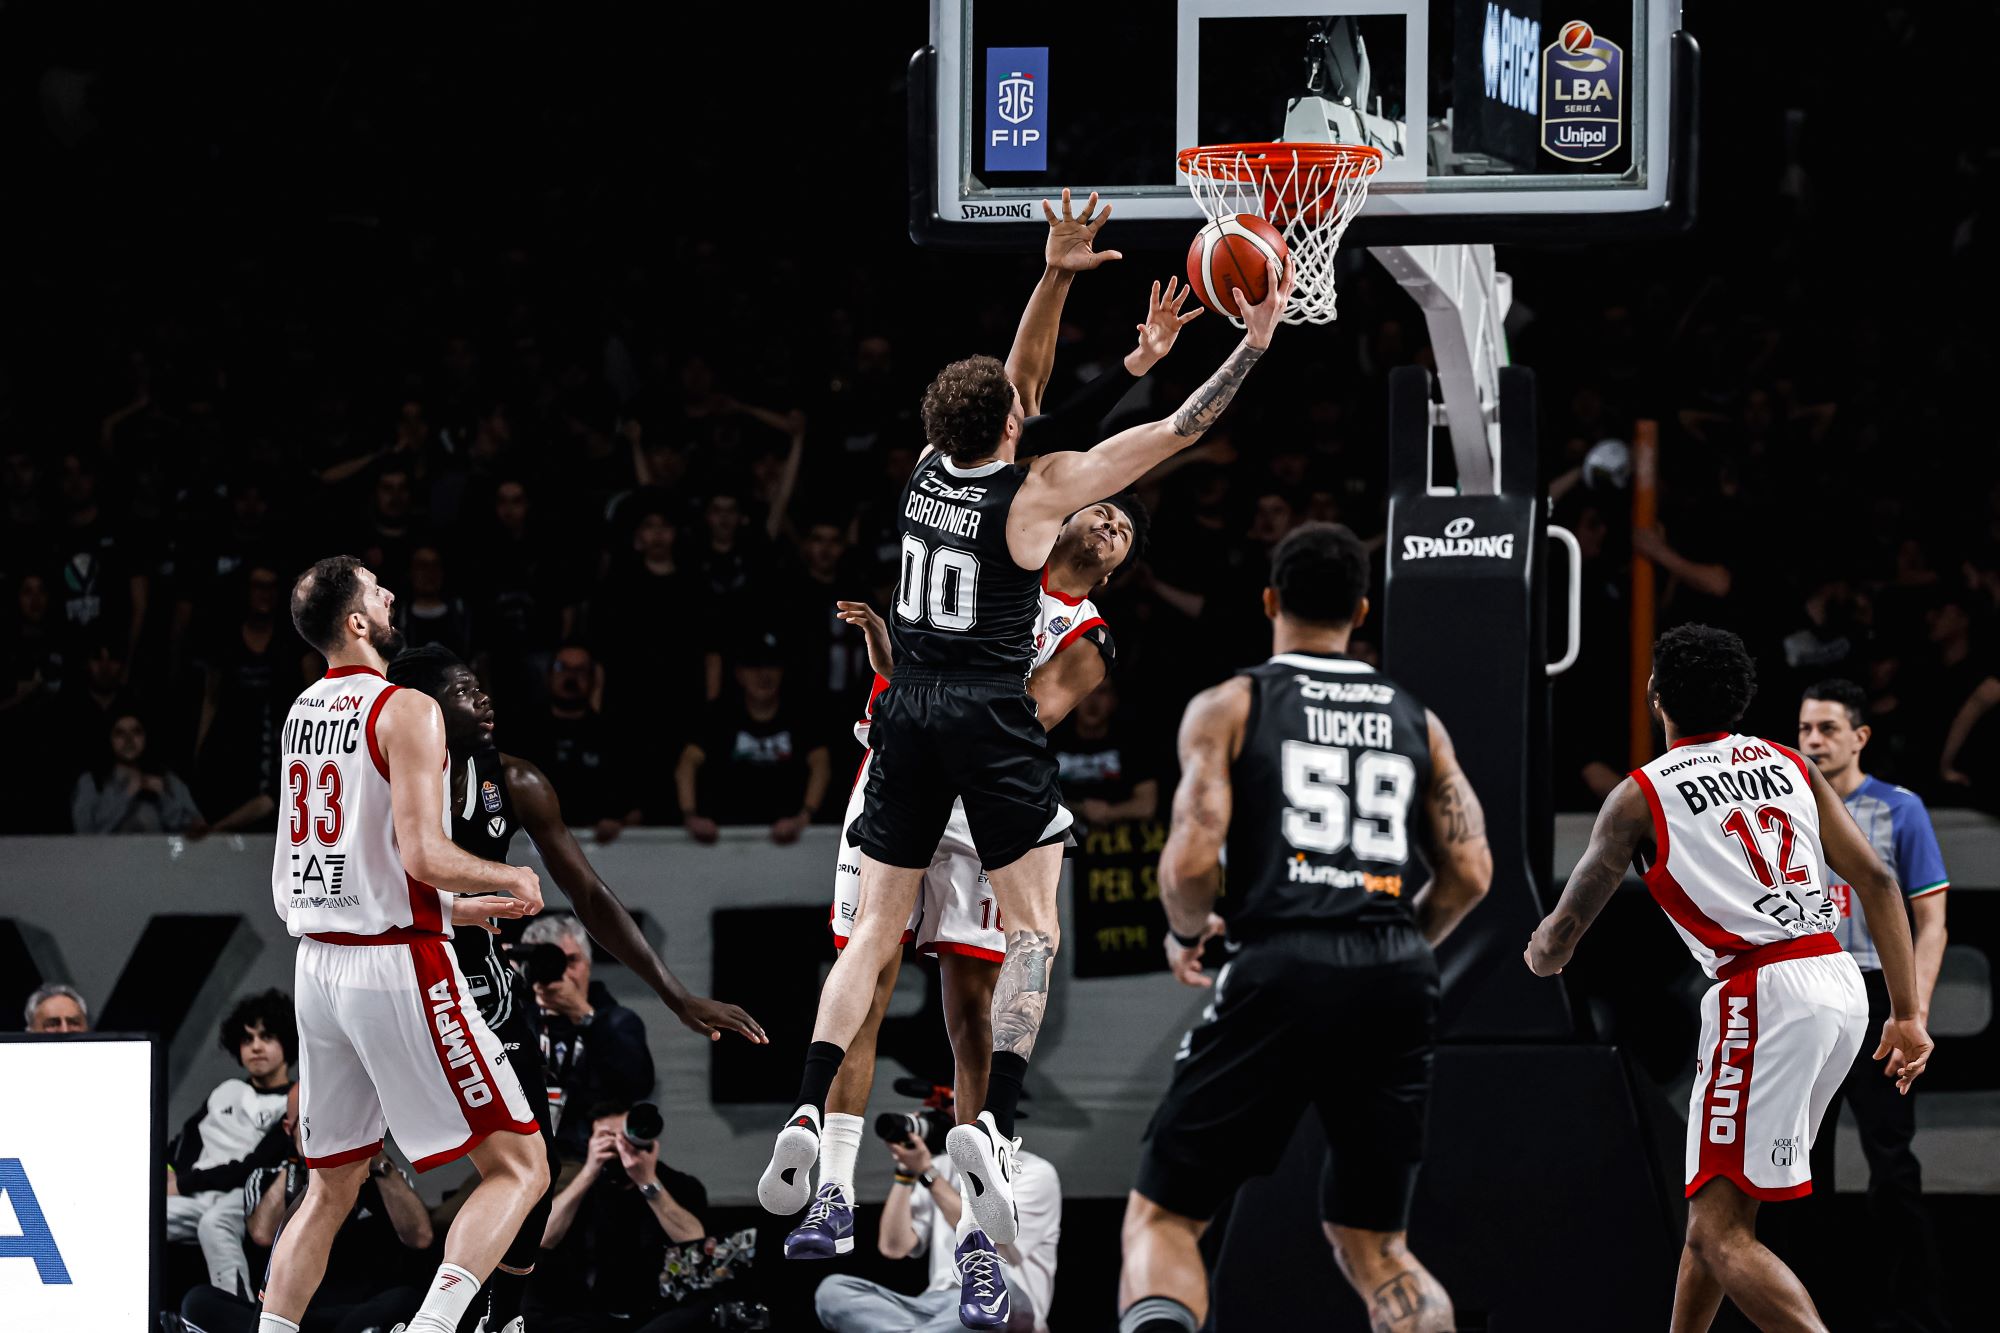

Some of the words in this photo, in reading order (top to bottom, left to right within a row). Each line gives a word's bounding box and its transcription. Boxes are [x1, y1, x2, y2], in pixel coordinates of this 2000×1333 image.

[1554, 79, 1613, 101] LBA
[1564, 104, 1592, 113] SERIE
[1593, 104, 1602, 113] A
[991, 129, 1041, 147] FIP
[1559, 126, 1607, 148] Unipol
[961, 202, 1031, 220] SPALDING
[904, 490, 982, 540] CORDINIER
[1402, 533, 1514, 561] SPALDING
[896, 531, 981, 632] 00
[328, 694, 364, 713] AON
[283, 711, 361, 756] MIROTIĆ
[1303, 705, 1393, 751] TUCKER
[1659, 755, 1722, 777] DRIVALIA
[1731, 745, 1772, 766] AON
[288, 759, 344, 848] 33
[1281, 738, 1417, 866] 59
[1675, 764, 1794, 816] BROOKS
[1720, 803, 1812, 891] 12
[427, 978, 493, 1108] OLIMPIA
[1708, 996, 1750, 1145] MILANO
